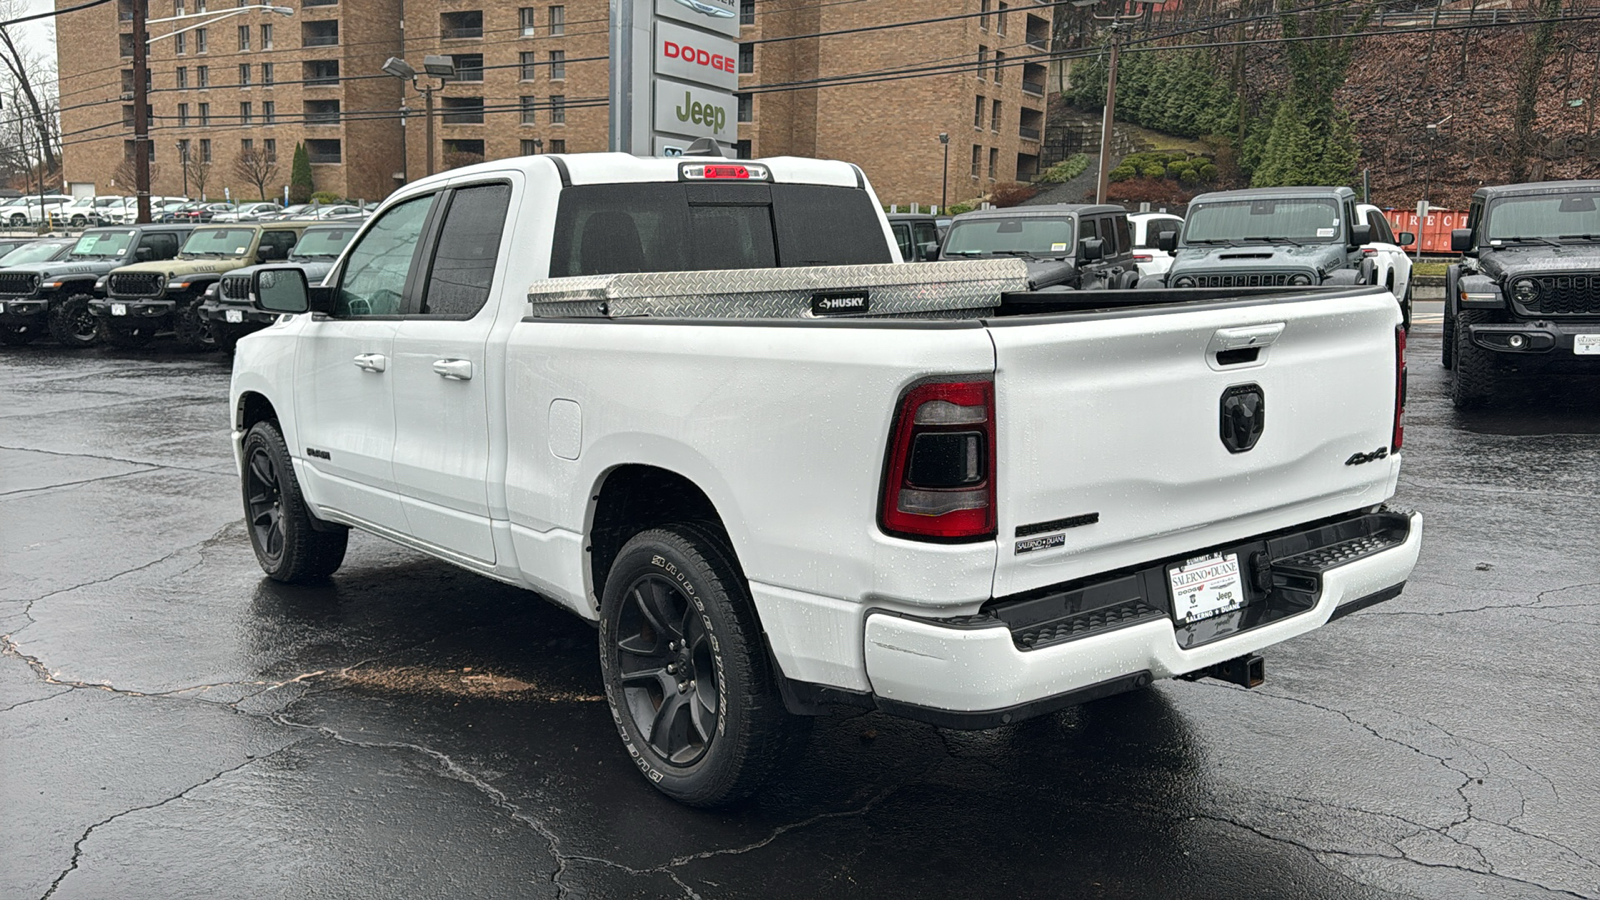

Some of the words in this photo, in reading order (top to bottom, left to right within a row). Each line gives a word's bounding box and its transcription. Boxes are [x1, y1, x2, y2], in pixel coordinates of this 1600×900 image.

[664, 41, 736, 74] DODGE
[676, 91, 726, 134] Jeep
[831, 297, 865, 308] HUSKY
[1172, 569, 1208, 587] SALERNO
[1210, 562, 1238, 577] DUANE
[1216, 591, 1233, 601] Jeep
[651, 554, 727, 737] BRIDGESTONE
[605, 683, 663, 784] DUELER
